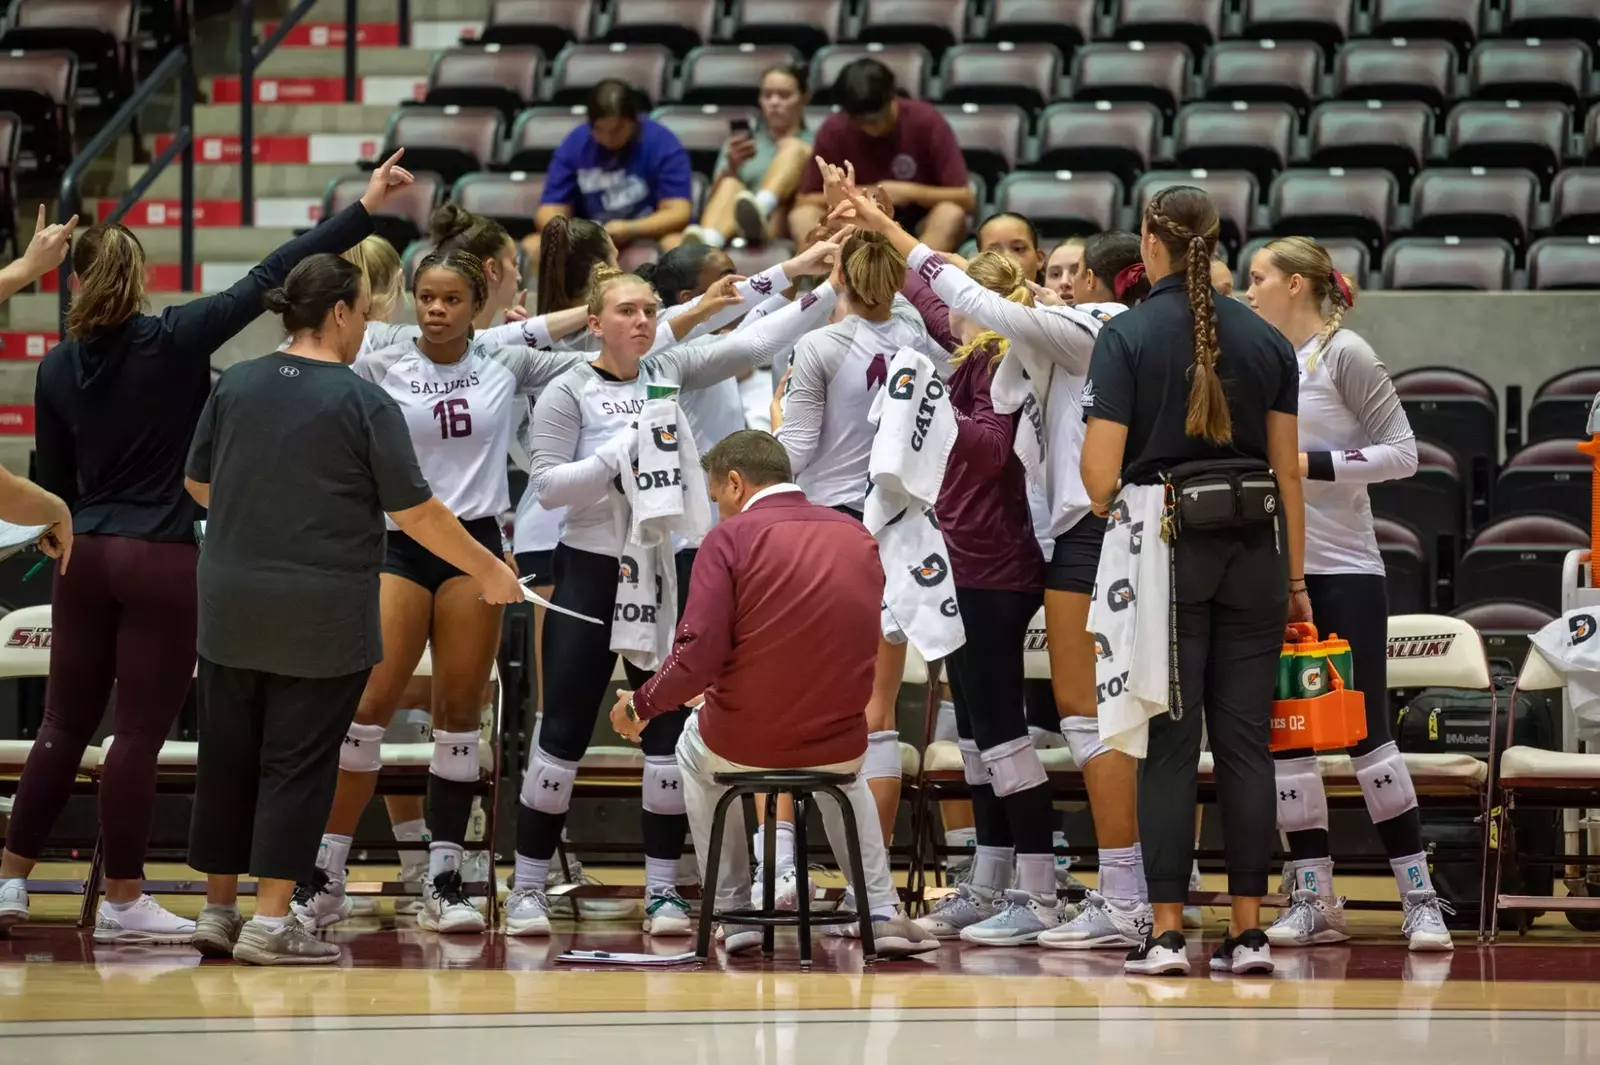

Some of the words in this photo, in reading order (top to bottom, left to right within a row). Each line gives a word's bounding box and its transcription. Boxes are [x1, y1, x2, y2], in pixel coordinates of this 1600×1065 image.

[433, 398, 472, 439] 16
[602, 398, 647, 415] SALU
[911, 369, 944, 452] GATO
[1289, 715, 1305, 730] 02
